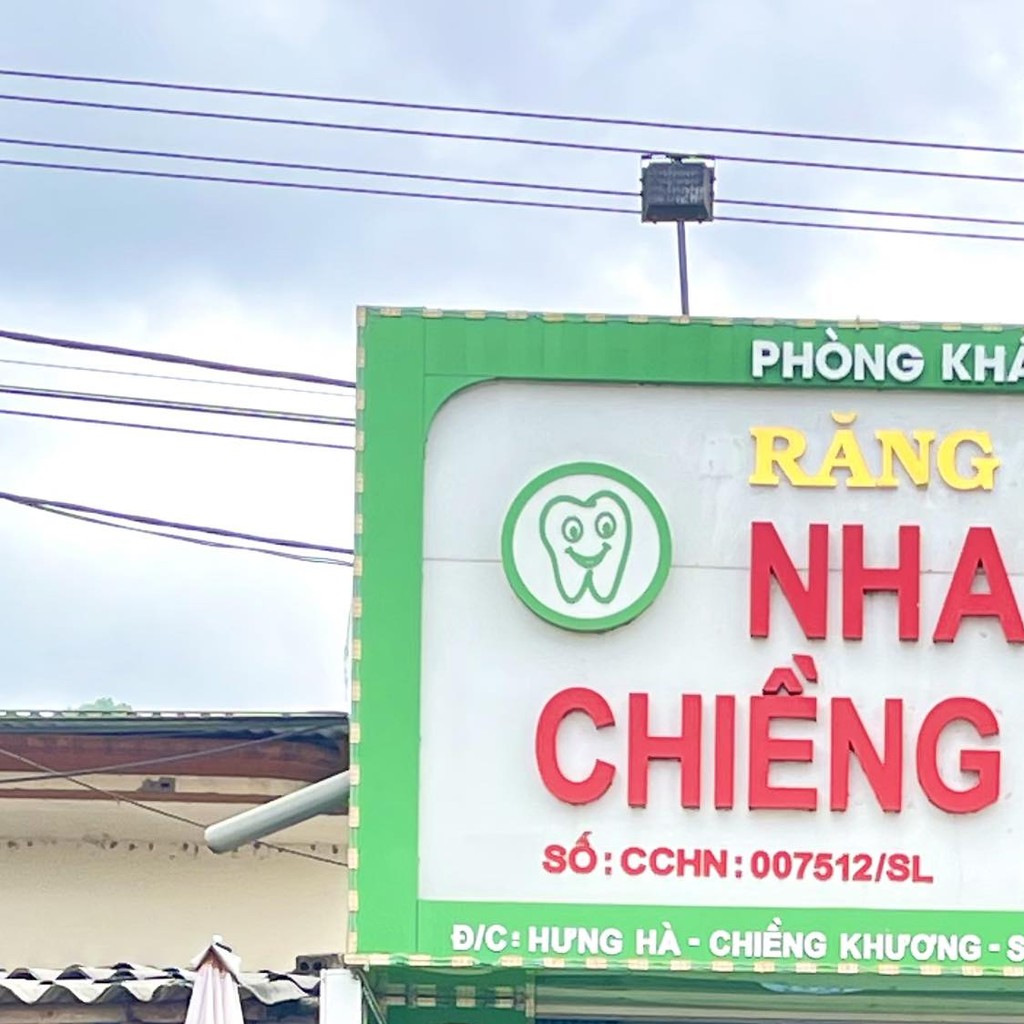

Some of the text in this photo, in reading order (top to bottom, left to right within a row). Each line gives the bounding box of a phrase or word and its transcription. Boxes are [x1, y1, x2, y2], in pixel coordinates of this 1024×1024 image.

[752, 327, 925, 382] PHÒNG
[749, 412, 1000, 492] RĂNG
[535, 654, 1002, 815] CHIỀNG
[750, 850, 934, 884] 007512/SL
[528, 925, 624, 955] HƯNG
[636, 921, 682, 956] HÀ
[709, 917, 827, 959] CHIỀNG
[840, 932, 982, 961] KHƯƠNG
